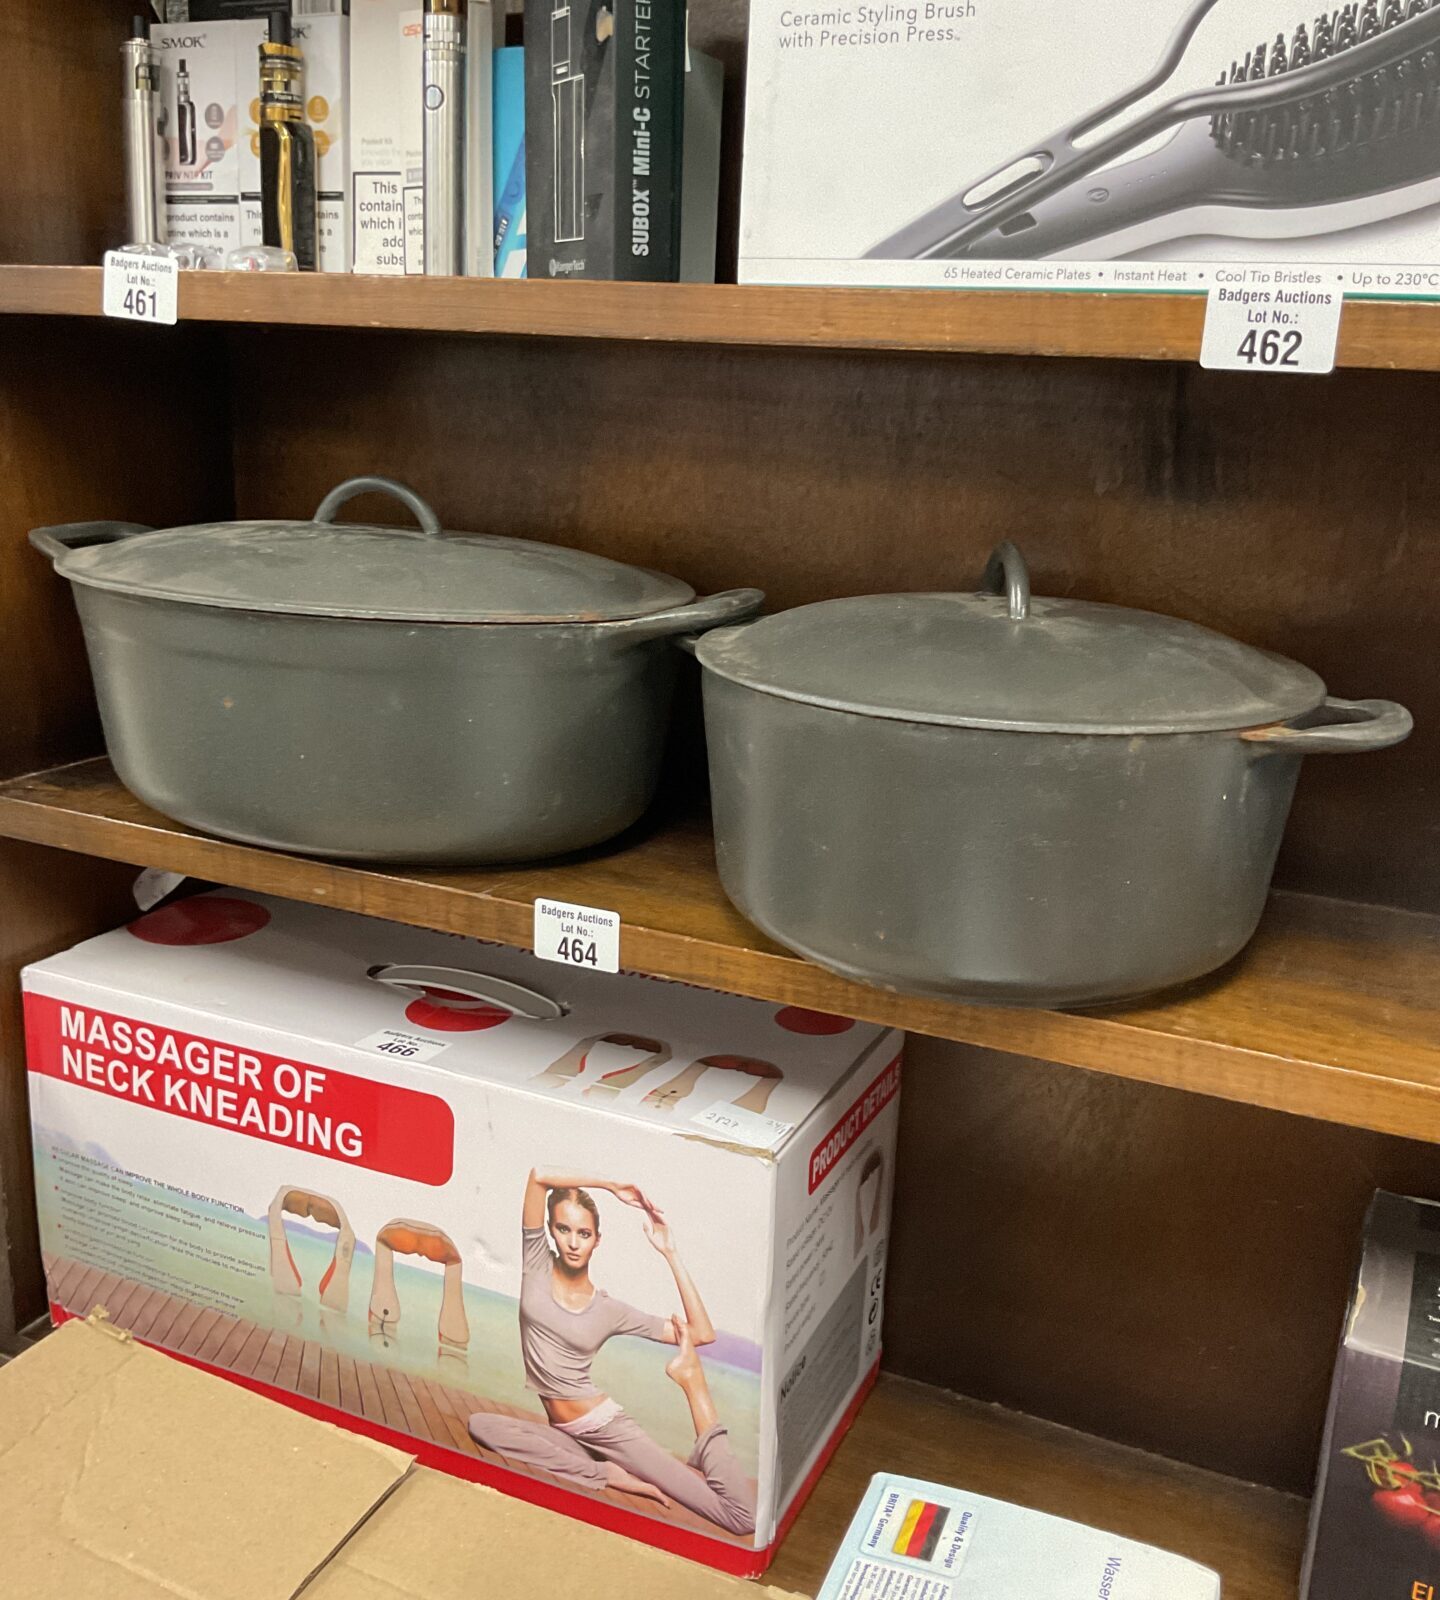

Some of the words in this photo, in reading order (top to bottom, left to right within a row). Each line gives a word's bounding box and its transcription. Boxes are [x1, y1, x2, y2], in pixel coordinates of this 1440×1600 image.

[780, 8, 852, 27] Ceramic
[857, 5, 918, 27] Styling
[925, 0, 976, 20] Brush
[779, 30, 814, 49] with
[820, 28, 900, 47] Precision
[633, 107, 651, 176] Mini-C
[372, 182, 398, 194] This
[200, 213, 234, 222] contains
[361, 217, 395, 230] which
[188, 229, 212, 238] which
[214, 230, 221, 238] is
[110, 256, 140, 270] Badgers
[141, 260, 172, 274] Auctions
[127, 273, 138, 285] Lot
[943, 267, 958, 279] 65
[961, 267, 1002, 280] Heated
[1005, 268, 1054, 280] Ceramic
[1056, 268, 1092, 281] Plates
[1113, 269, 1154, 282] Instant
[1157, 269, 1188, 282] Heat
[1215, 270, 1246, 283] Cool
[1274, 271, 1322, 284] Bristles
[1352, 272, 1373, 287] Up
[1376, 274, 1391, 286] to
[123, 288, 157, 318] 461
[1218, 288, 1271, 304] Badgers
[1275, 290, 1332, 305] Auctions
[1247, 309, 1268, 324] Lot
[1271, 310, 1299, 325] No.:
[1236, 329, 1303, 367] 462
[541, 904, 575, 919] Badgers
[576, 912, 614, 927] Auctions
[561, 922, 574, 934] Lot
[576, 926, 594, 938] No.:
[557, 936, 598, 966] 464
[61, 1006, 262, 1091] MASSAGER
[273, 1064, 326, 1104] OF
[376, 1042, 420, 1057] 466
[62, 1046, 155, 1100] NECK
[164, 1079, 364, 1158] KNEADING
[812, 1105, 862, 1184] PRODUCT
[862, 1062, 901, 1122] DETAILS
[124, 1170, 152, 1183] IMPROVE
[153, 1179, 165, 1189] THE
[166, 1183, 189, 1196] WHOLE
[191, 1191, 210, 1203] BODY
[211, 1198, 245, 1213] FUNCTION
[238, 1227, 266, 1240] pressure
[867, 1518, 889, 1548] Germany
[955, 1511, 973, 1536] Quality
[944, 1543, 962, 1569] Design
